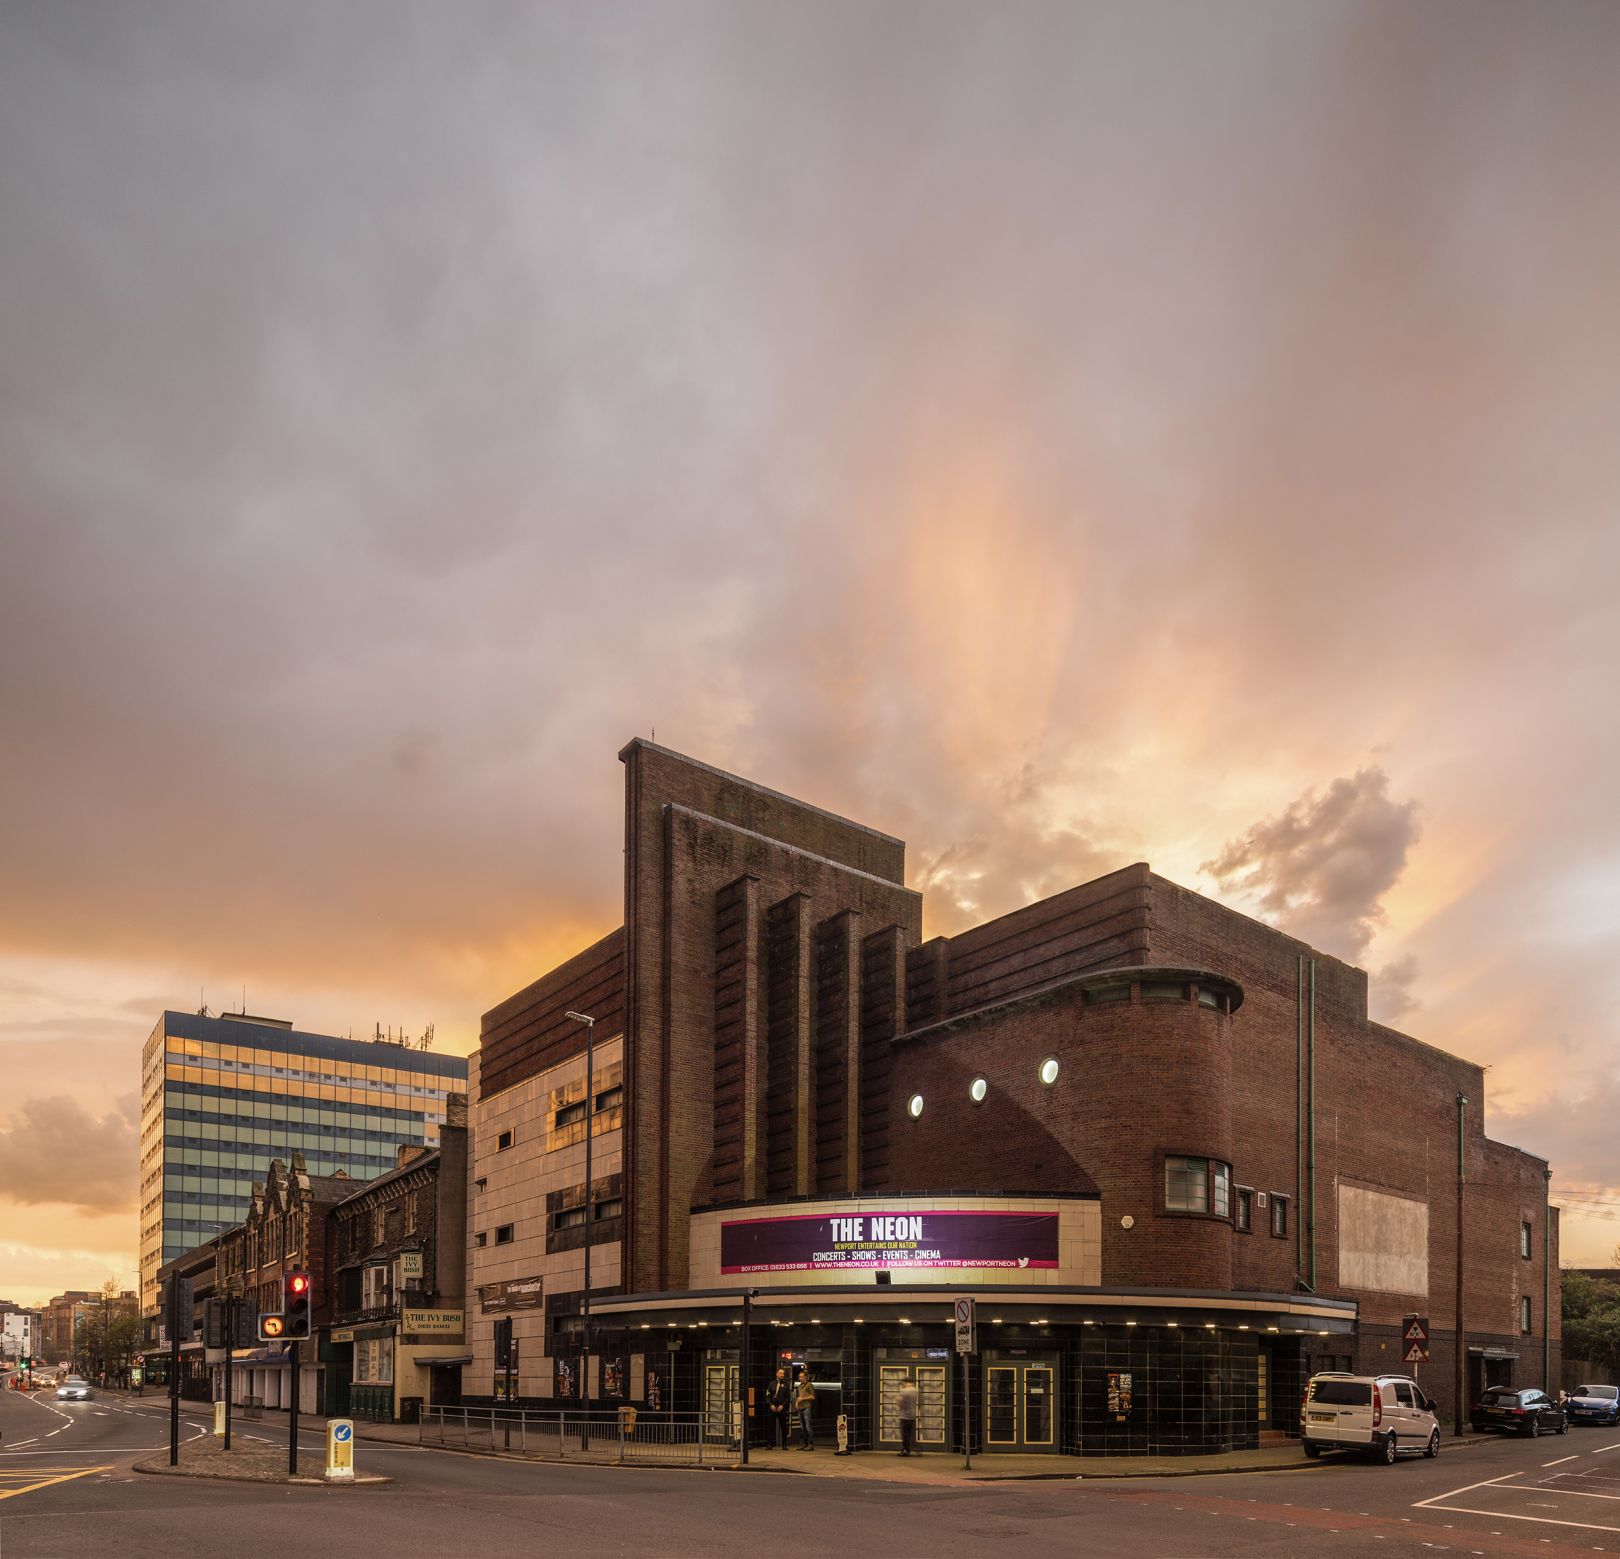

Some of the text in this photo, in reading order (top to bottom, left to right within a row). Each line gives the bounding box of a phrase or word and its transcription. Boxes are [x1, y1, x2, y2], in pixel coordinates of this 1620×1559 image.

[830, 1216, 922, 1242] THE NEON
[834, 1241, 918, 1251] NEWPORT ENTERTAINS OUR NATION
[812, 1251, 846, 1262] CONCERTS
[851, 1250, 876, 1261] SHOWS
[882, 1250, 908, 1260] EVENTS
[914, 1249, 941, 1260] CINEMA
[814, 1260, 879, 1268] WWW.THENEON.CO.UK
[887, 1260, 913, 1268] FOLLOW
[410, 1313, 426, 1321] THE
[442, 1314, 461, 1322] BUSH
